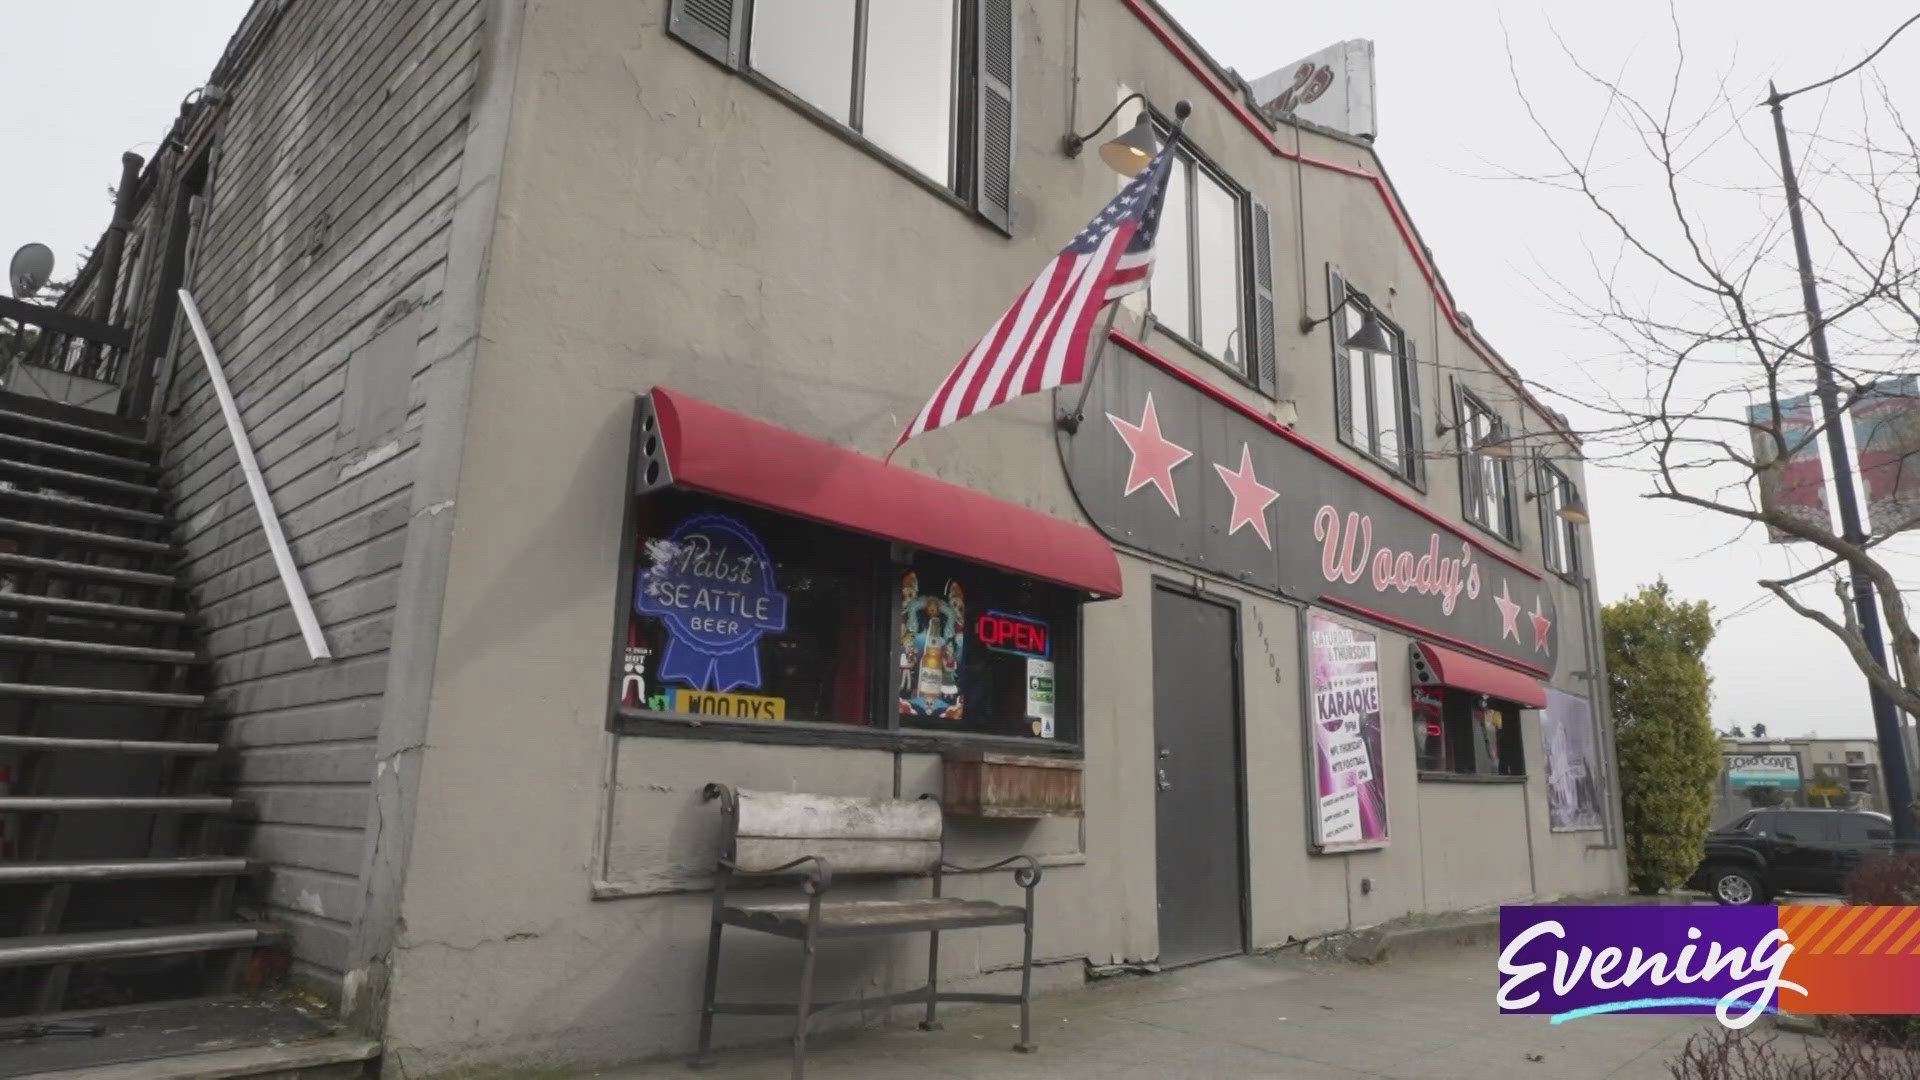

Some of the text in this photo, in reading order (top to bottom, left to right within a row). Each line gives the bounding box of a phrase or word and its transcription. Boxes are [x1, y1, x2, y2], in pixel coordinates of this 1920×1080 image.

[681, 534, 753, 584] Pabst
[1314, 505, 1480, 616] Woody's
[658, 581, 770, 620] SEATTLE
[690, 617, 739, 635] BEER
[979, 616, 1045, 652] OPEN
[1312, 629, 1354, 647] SATURDAY
[1252, 605, 1281, 684] 19508
[1332, 645, 1371, 661] THURSDAY
[1317, 687, 1378, 720] KARAOKE
[1761, 755, 1796, 771] COVE
